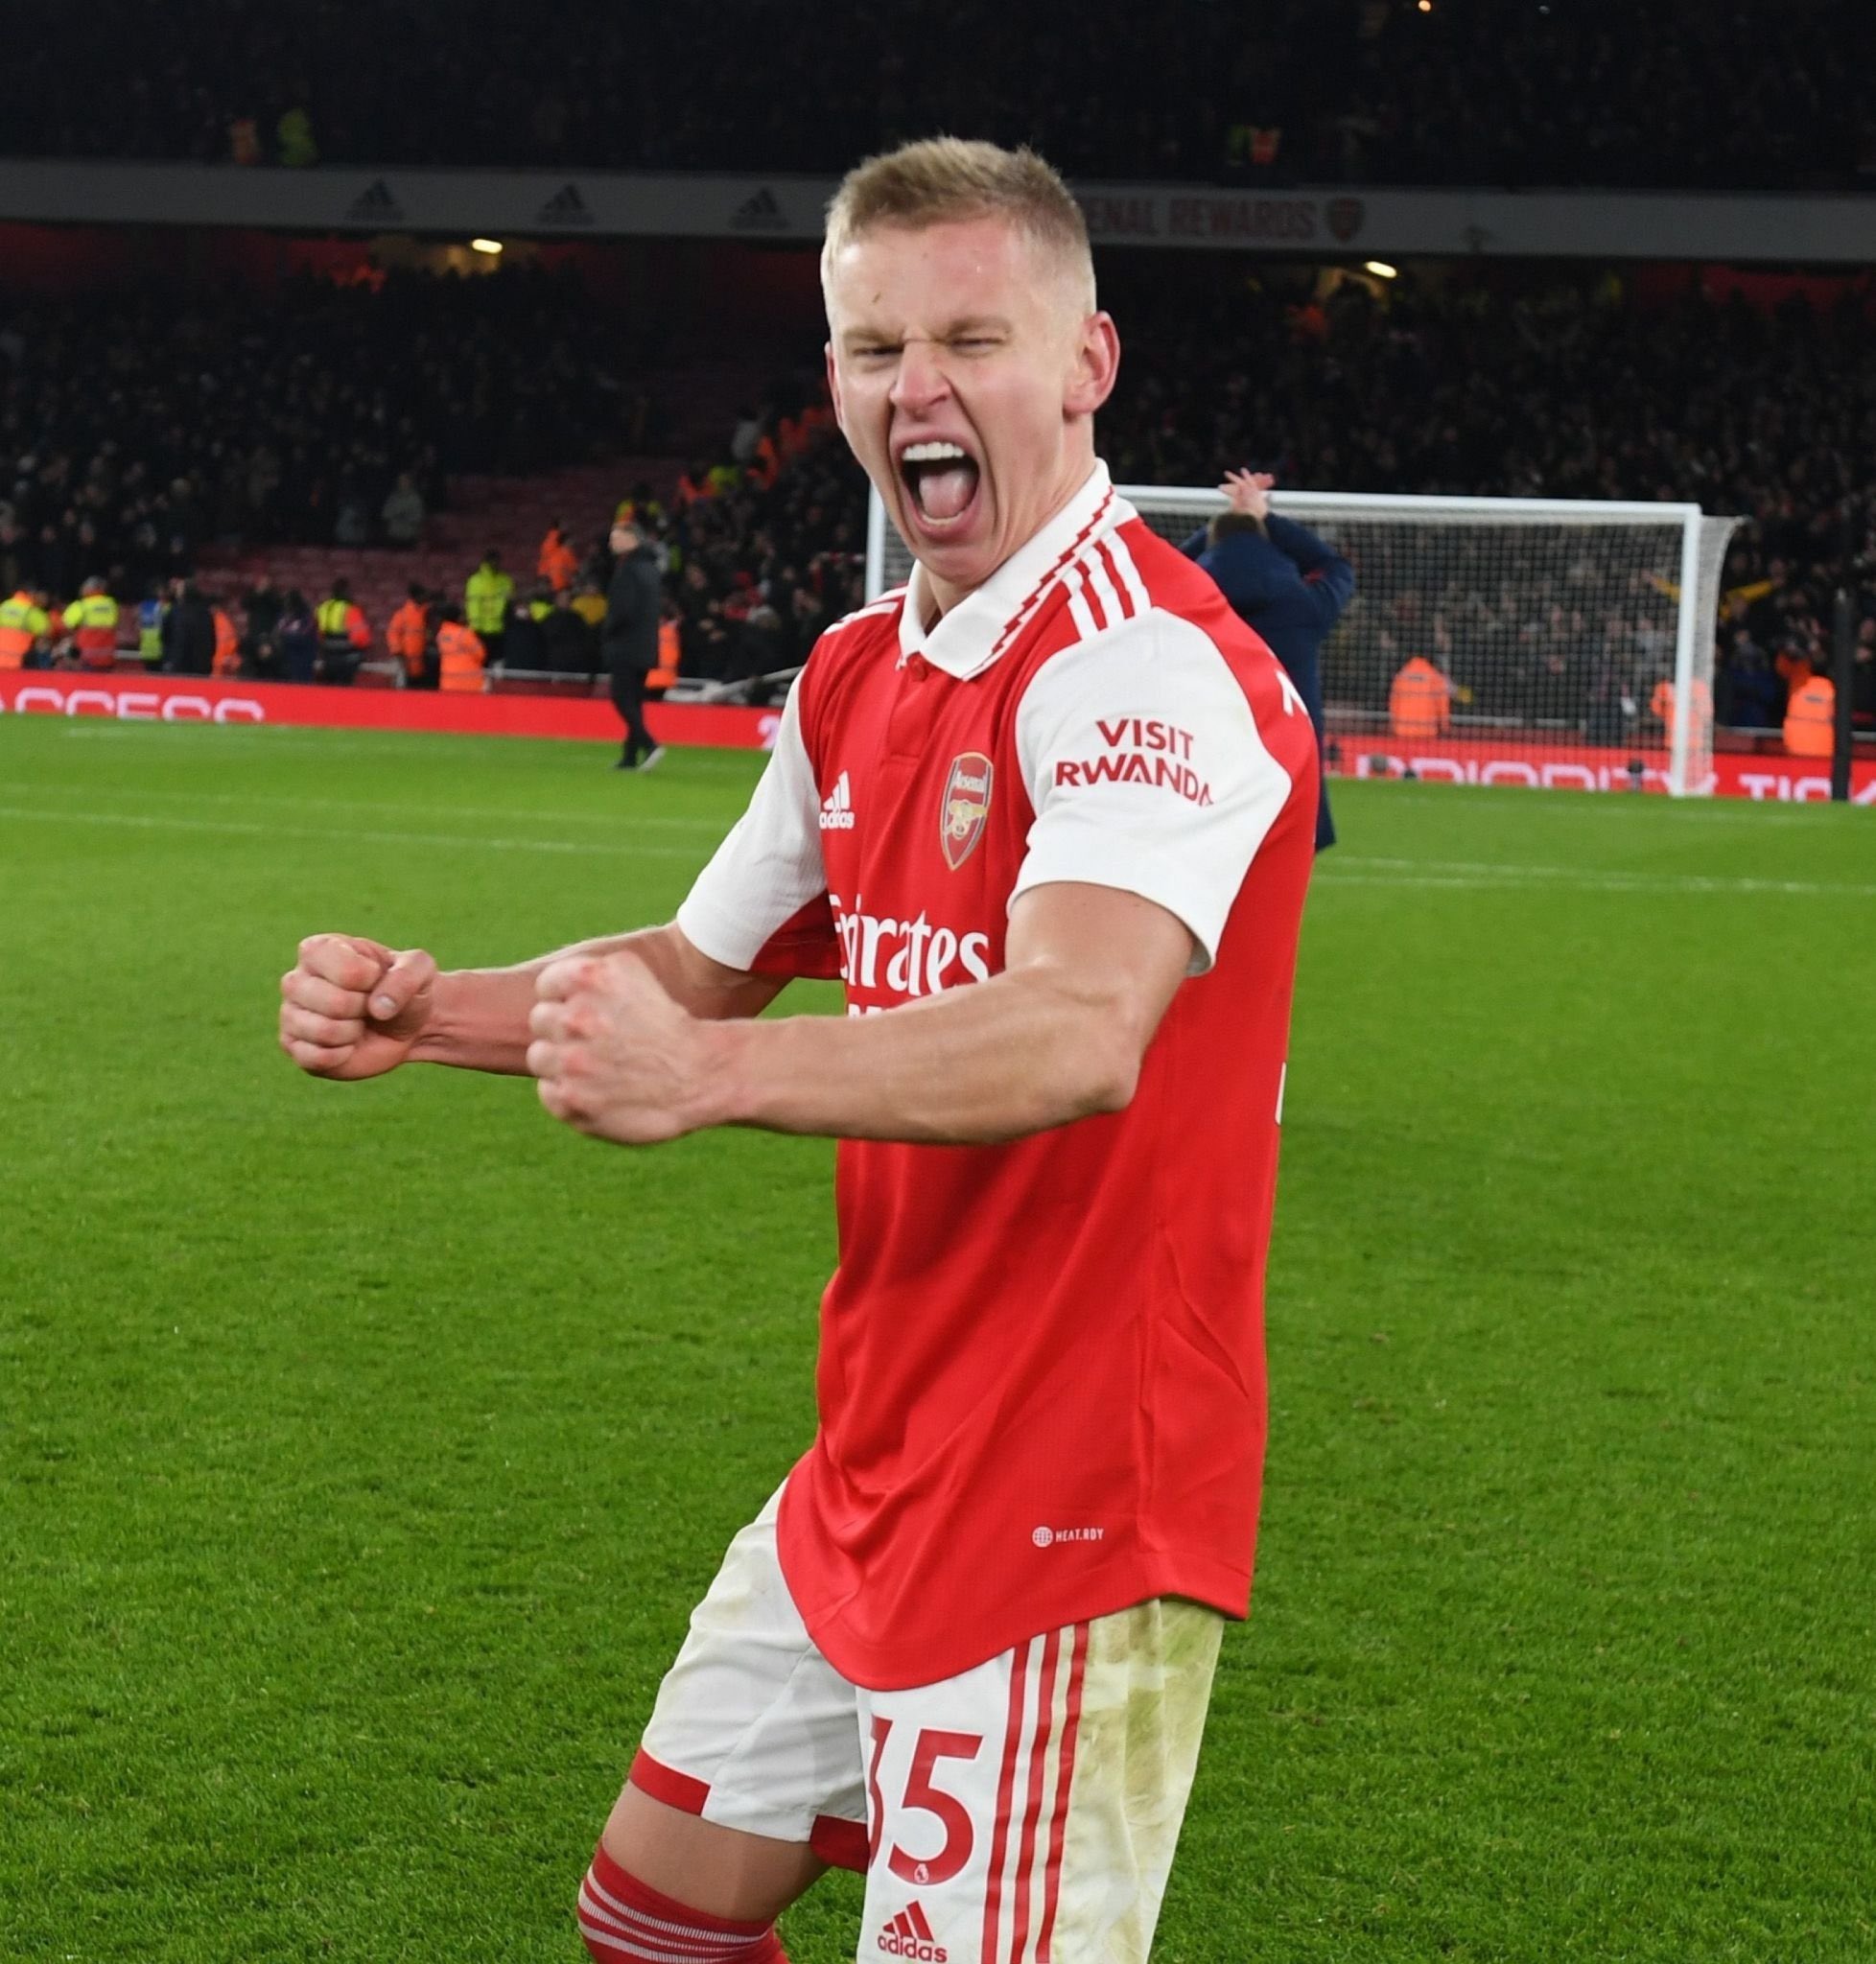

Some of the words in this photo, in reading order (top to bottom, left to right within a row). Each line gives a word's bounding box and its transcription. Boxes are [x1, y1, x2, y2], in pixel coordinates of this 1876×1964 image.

[1095, 718, 1194, 760] VISIT
[1055, 753, 1214, 807] RWANDA
[819, 807, 856, 830] adidas
[1055, 1527, 1104, 1543] HEAT.RDY
[877, 1933, 948, 1964] adidas
